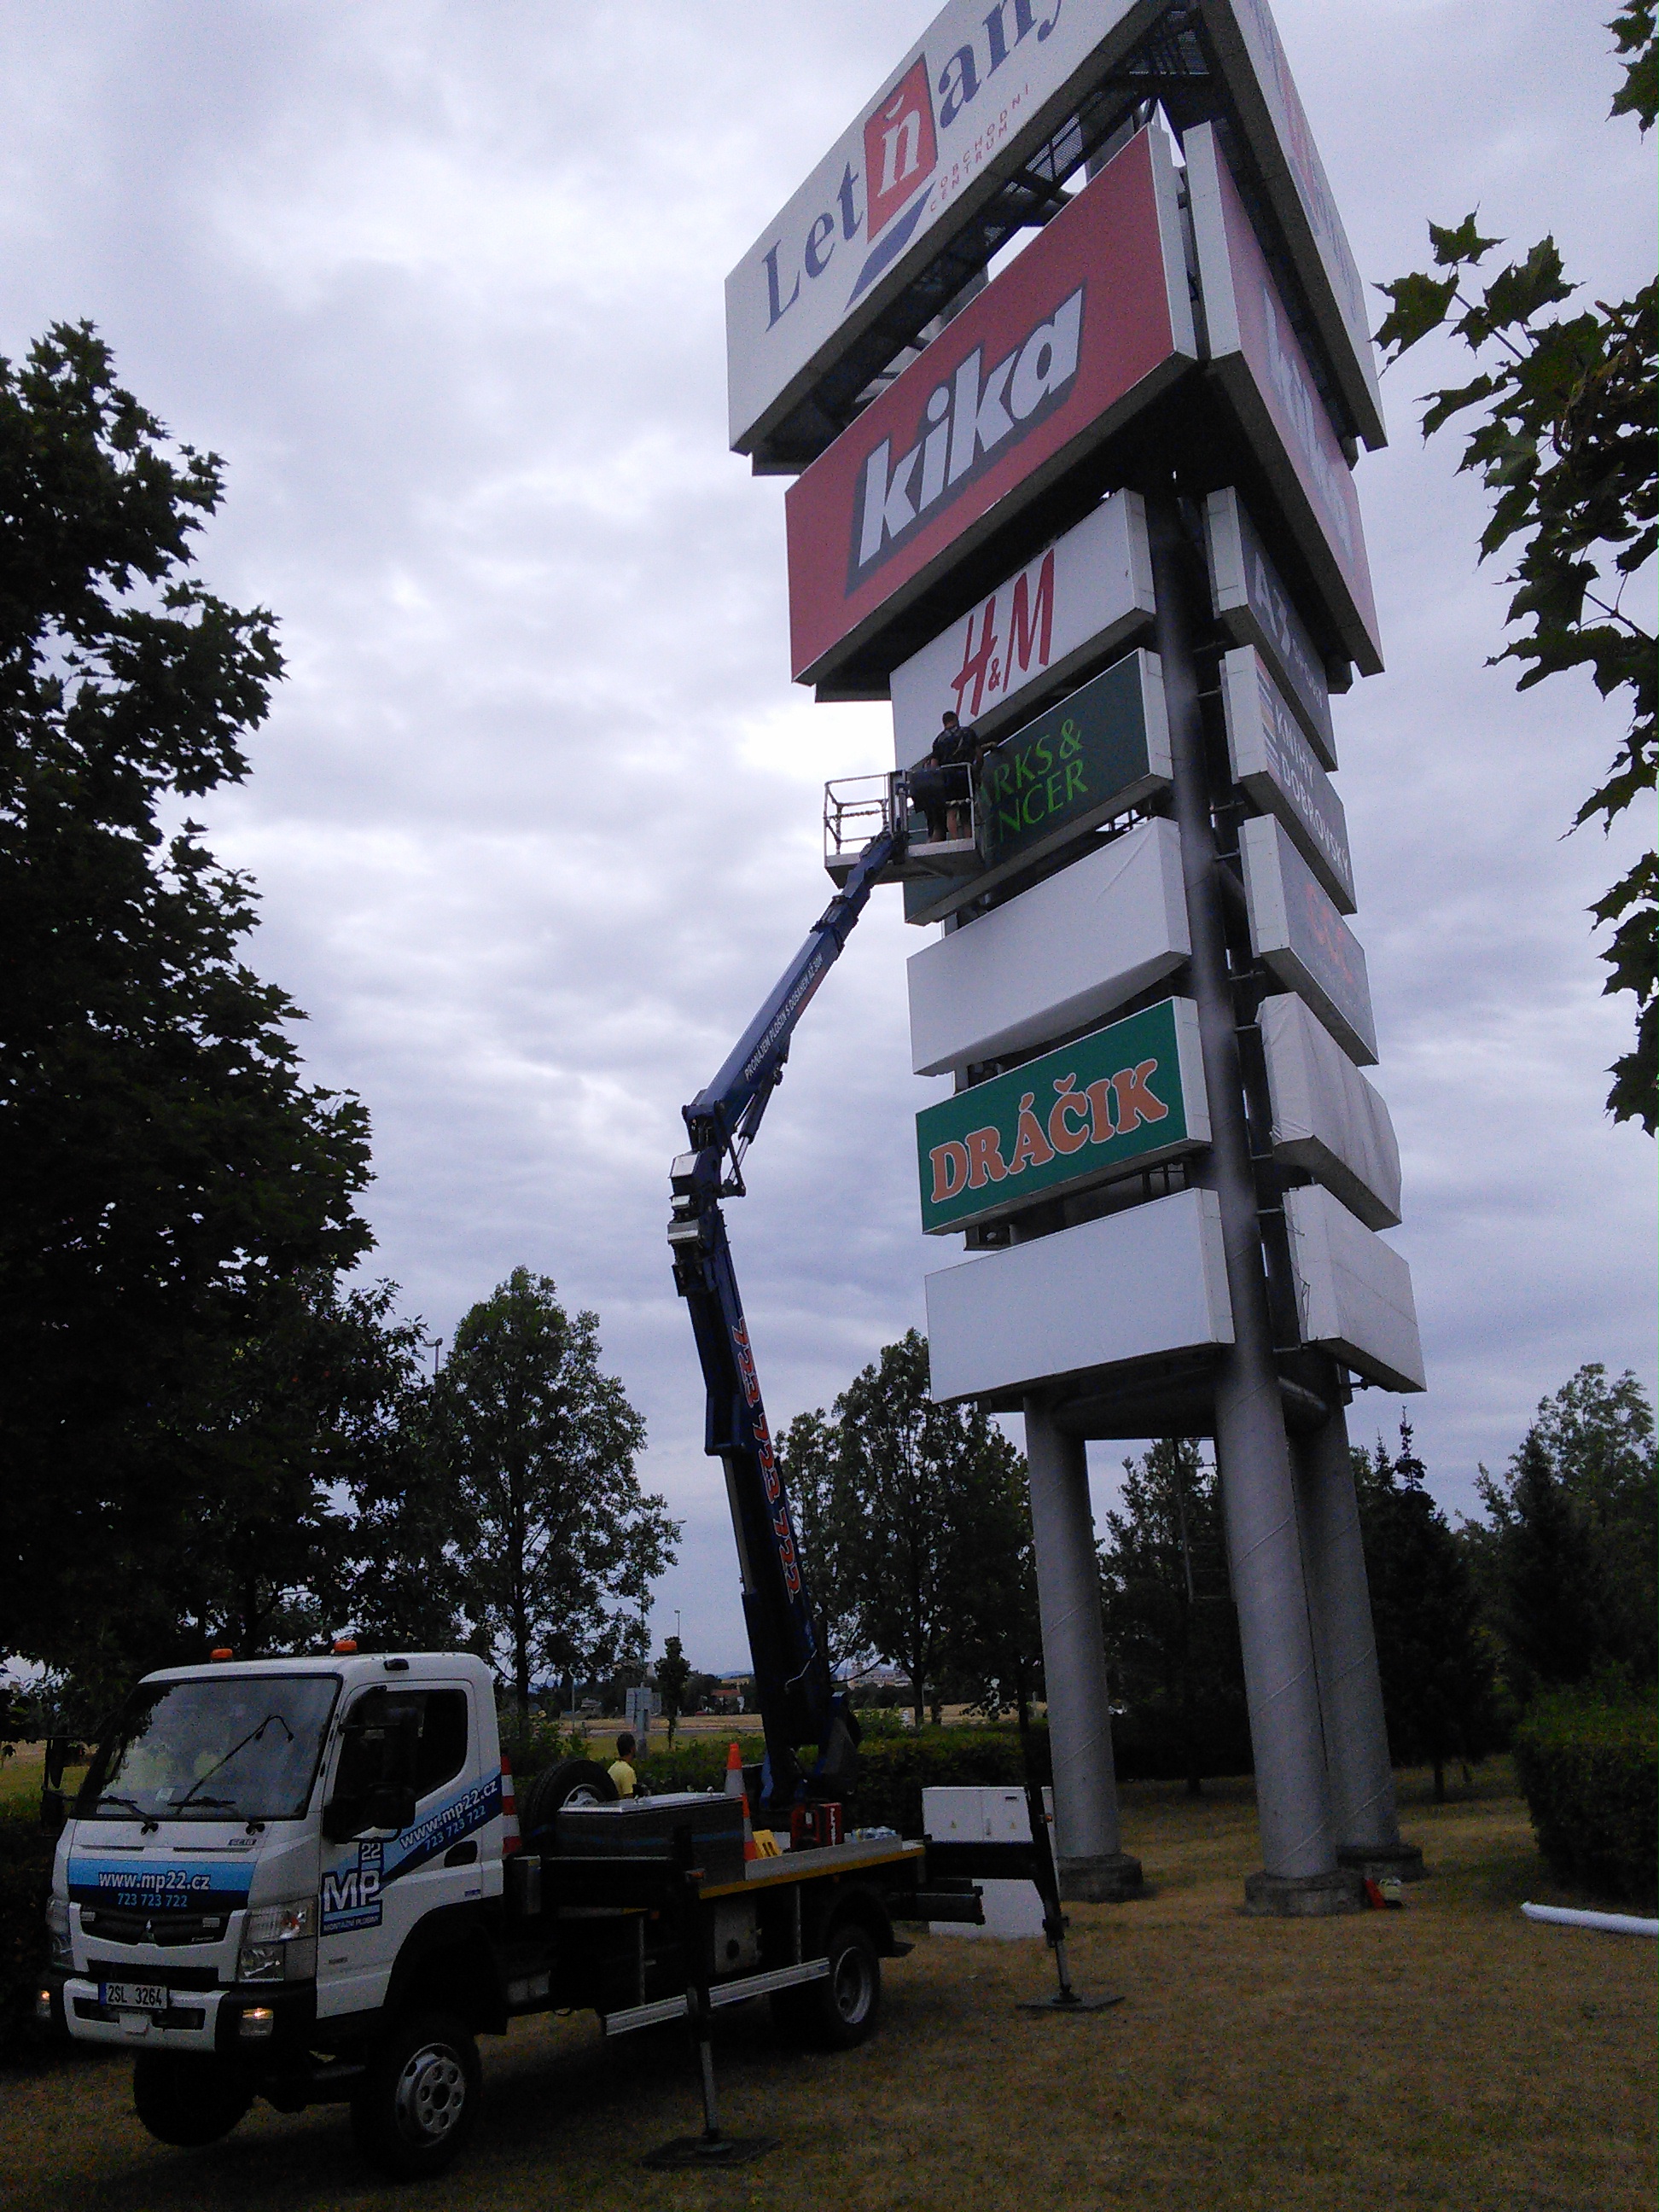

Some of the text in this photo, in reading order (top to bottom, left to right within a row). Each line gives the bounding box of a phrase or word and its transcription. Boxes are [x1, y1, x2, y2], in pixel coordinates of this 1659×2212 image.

[929, 120, 1009, 212] CENTRUM
[857, 285, 1084, 569] kika
[950, 547, 1056, 719] H&M
[981, 718, 1085, 804] RKS &
[988, 758, 1090, 844] NCER
[930, 1058, 1169, 1203] DRÁČIK
[731, 1315, 802, 1604] 723 723 722
[361, 1842, 381, 1860] 22
[400, 1780, 498, 1848] www.mp22.cz
[426, 1805, 486, 1851] 723 723 722
[99, 1871, 211, 1893] www.mp22.cz
[118, 1893, 188, 1908] 723 723 722
[323, 1870, 381, 1912] MP
[108, 1985, 163, 2006] 2SL 3264
